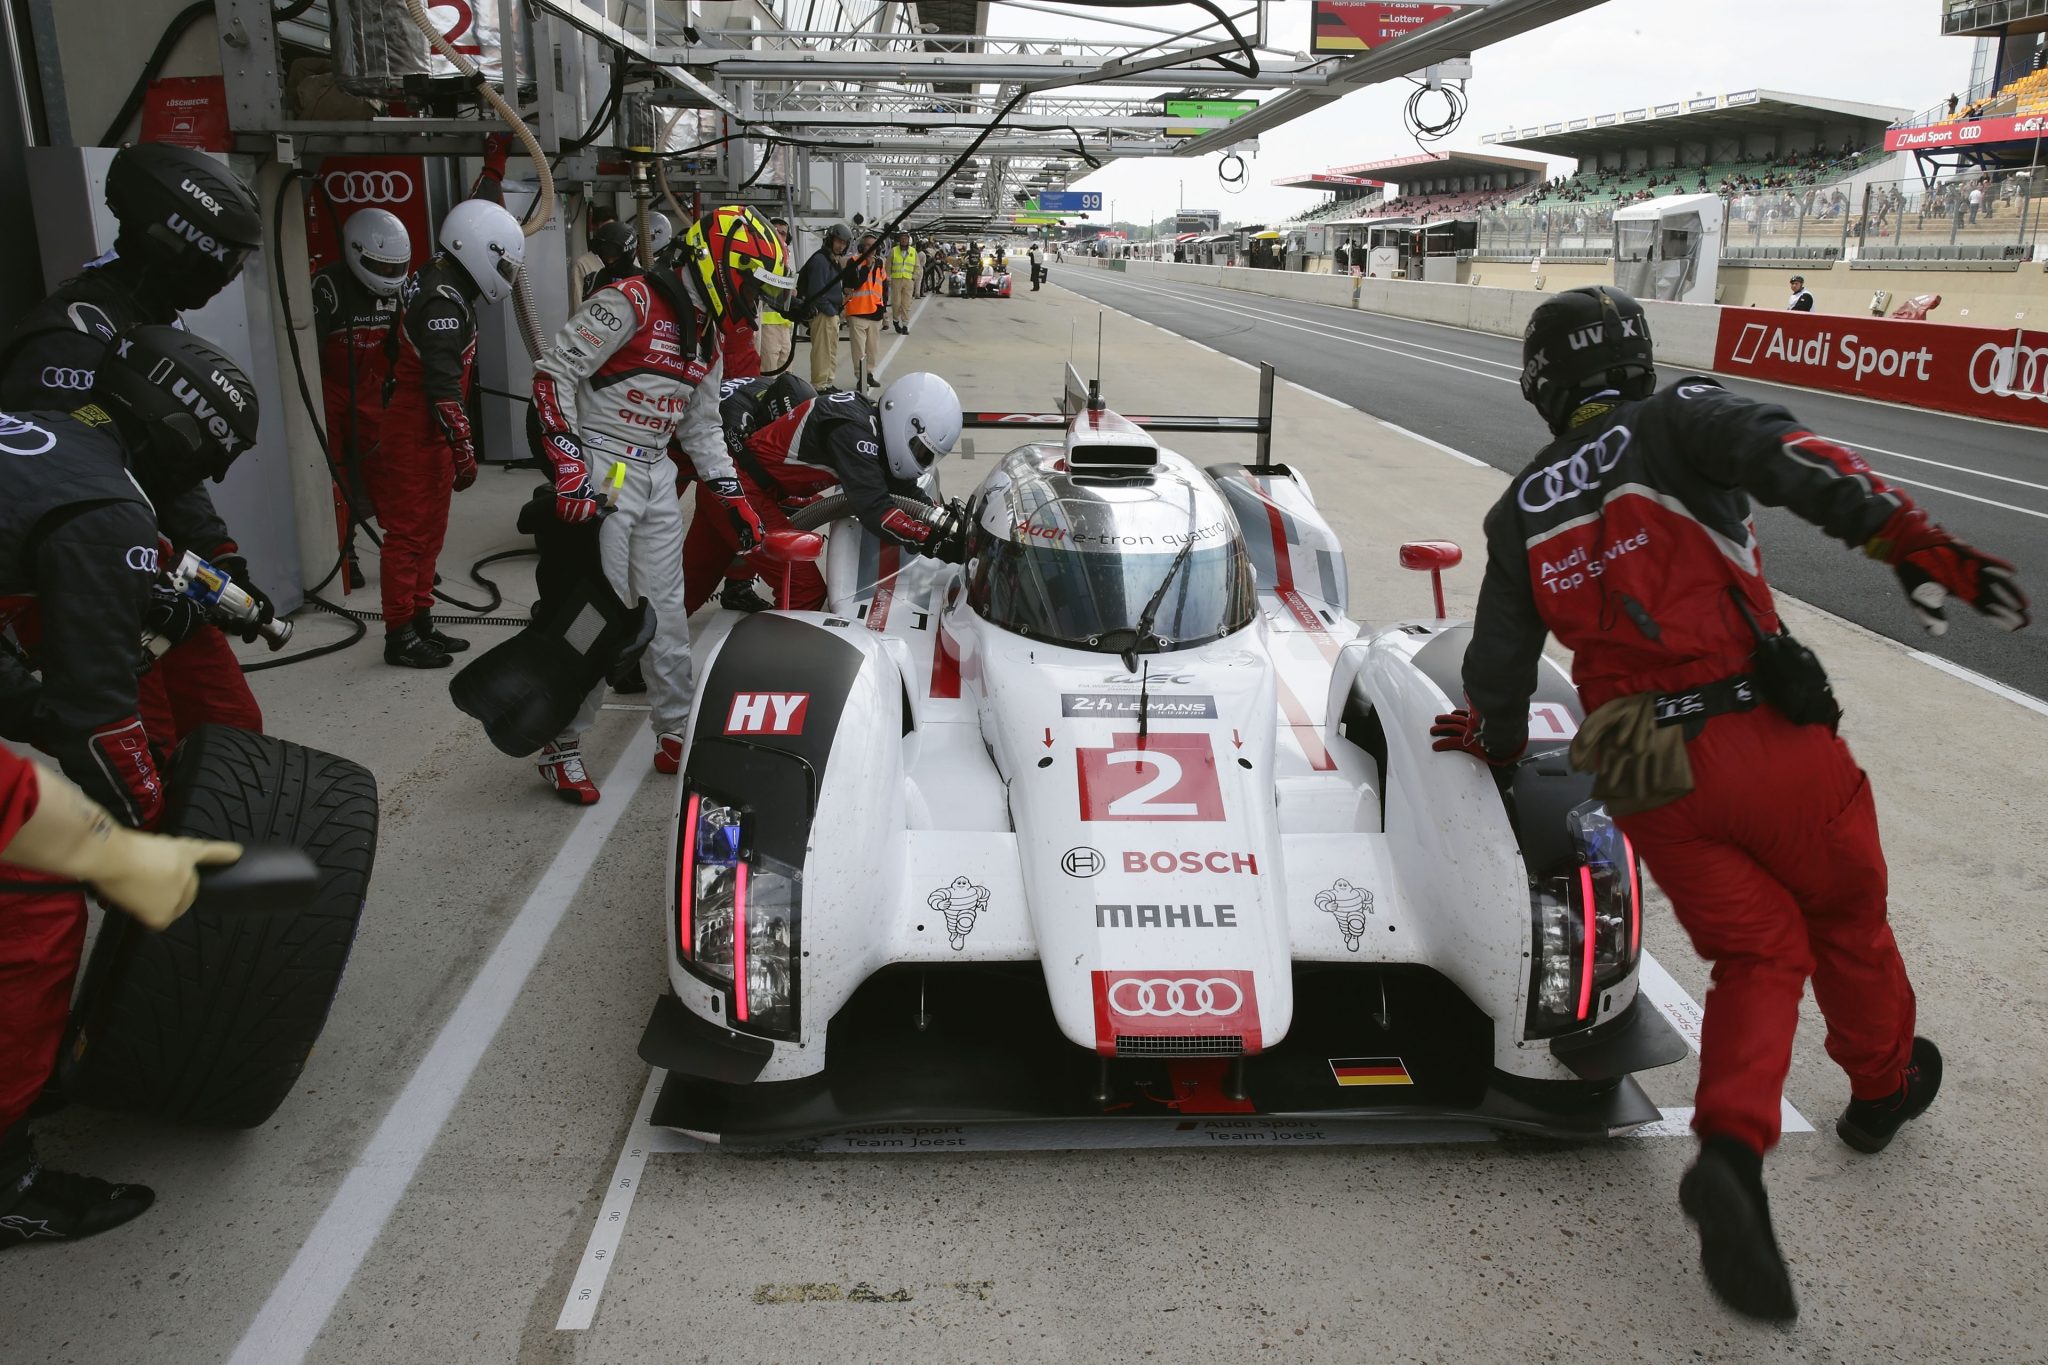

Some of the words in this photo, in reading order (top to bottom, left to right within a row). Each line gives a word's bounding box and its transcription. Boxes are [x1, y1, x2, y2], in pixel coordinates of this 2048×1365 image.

[1390, 14, 1424, 23] Lotterer
[1907, 133, 1926, 143] Audi
[1927, 131, 1952, 143] Sport
[180, 178, 224, 216] uvex
[1082, 194, 1100, 208] 99
[167, 212, 231, 262] uvex
[763, 273, 777, 282] Audi
[578, 327, 602, 347] Castrol
[1568, 319, 1637, 350] uvx
[661, 356, 685, 370] Audi
[1765, 328, 1831, 367] Audi
[1837, 335, 1933, 381] Sport
[211, 369, 247, 412] uvex
[172, 376, 241, 452] uvex
[1015, 518, 1067, 541] Audi
[1072, 533, 1154, 546] e-tron
[1161, 520, 1226, 547] quattro
[1540, 546, 1587, 579] Audi
[1542, 573, 1585, 594] Top
[1586, 531, 1649, 578] Svice
[727, 694, 807, 732] HY
[1117, 703, 1142, 711] LE
[1146, 703, 1207, 712] MANS
[131, 751, 151, 776] Audi
[1105, 749, 1199, 816] 2
[1122, 850, 1260, 876] BOSCH
[1095, 904, 1238, 928] MAHLE
[1663, 1002, 1694, 1031] Sport
[902, 1125, 964, 1137] Sport
[1206, 1131, 1265, 1141] Team
[1271, 1130, 1326, 1141] Joest
[630, 1149, 642, 1158] 10
[846, 1137, 904, 1148] Team
[911, 1137, 966, 1148] Joest
[620, 1178, 631, 1189] 20
[609, 1211, 621, 1222] 30
[594, 1249, 607, 1261] 40
[578, 1288, 592, 1301] 50
